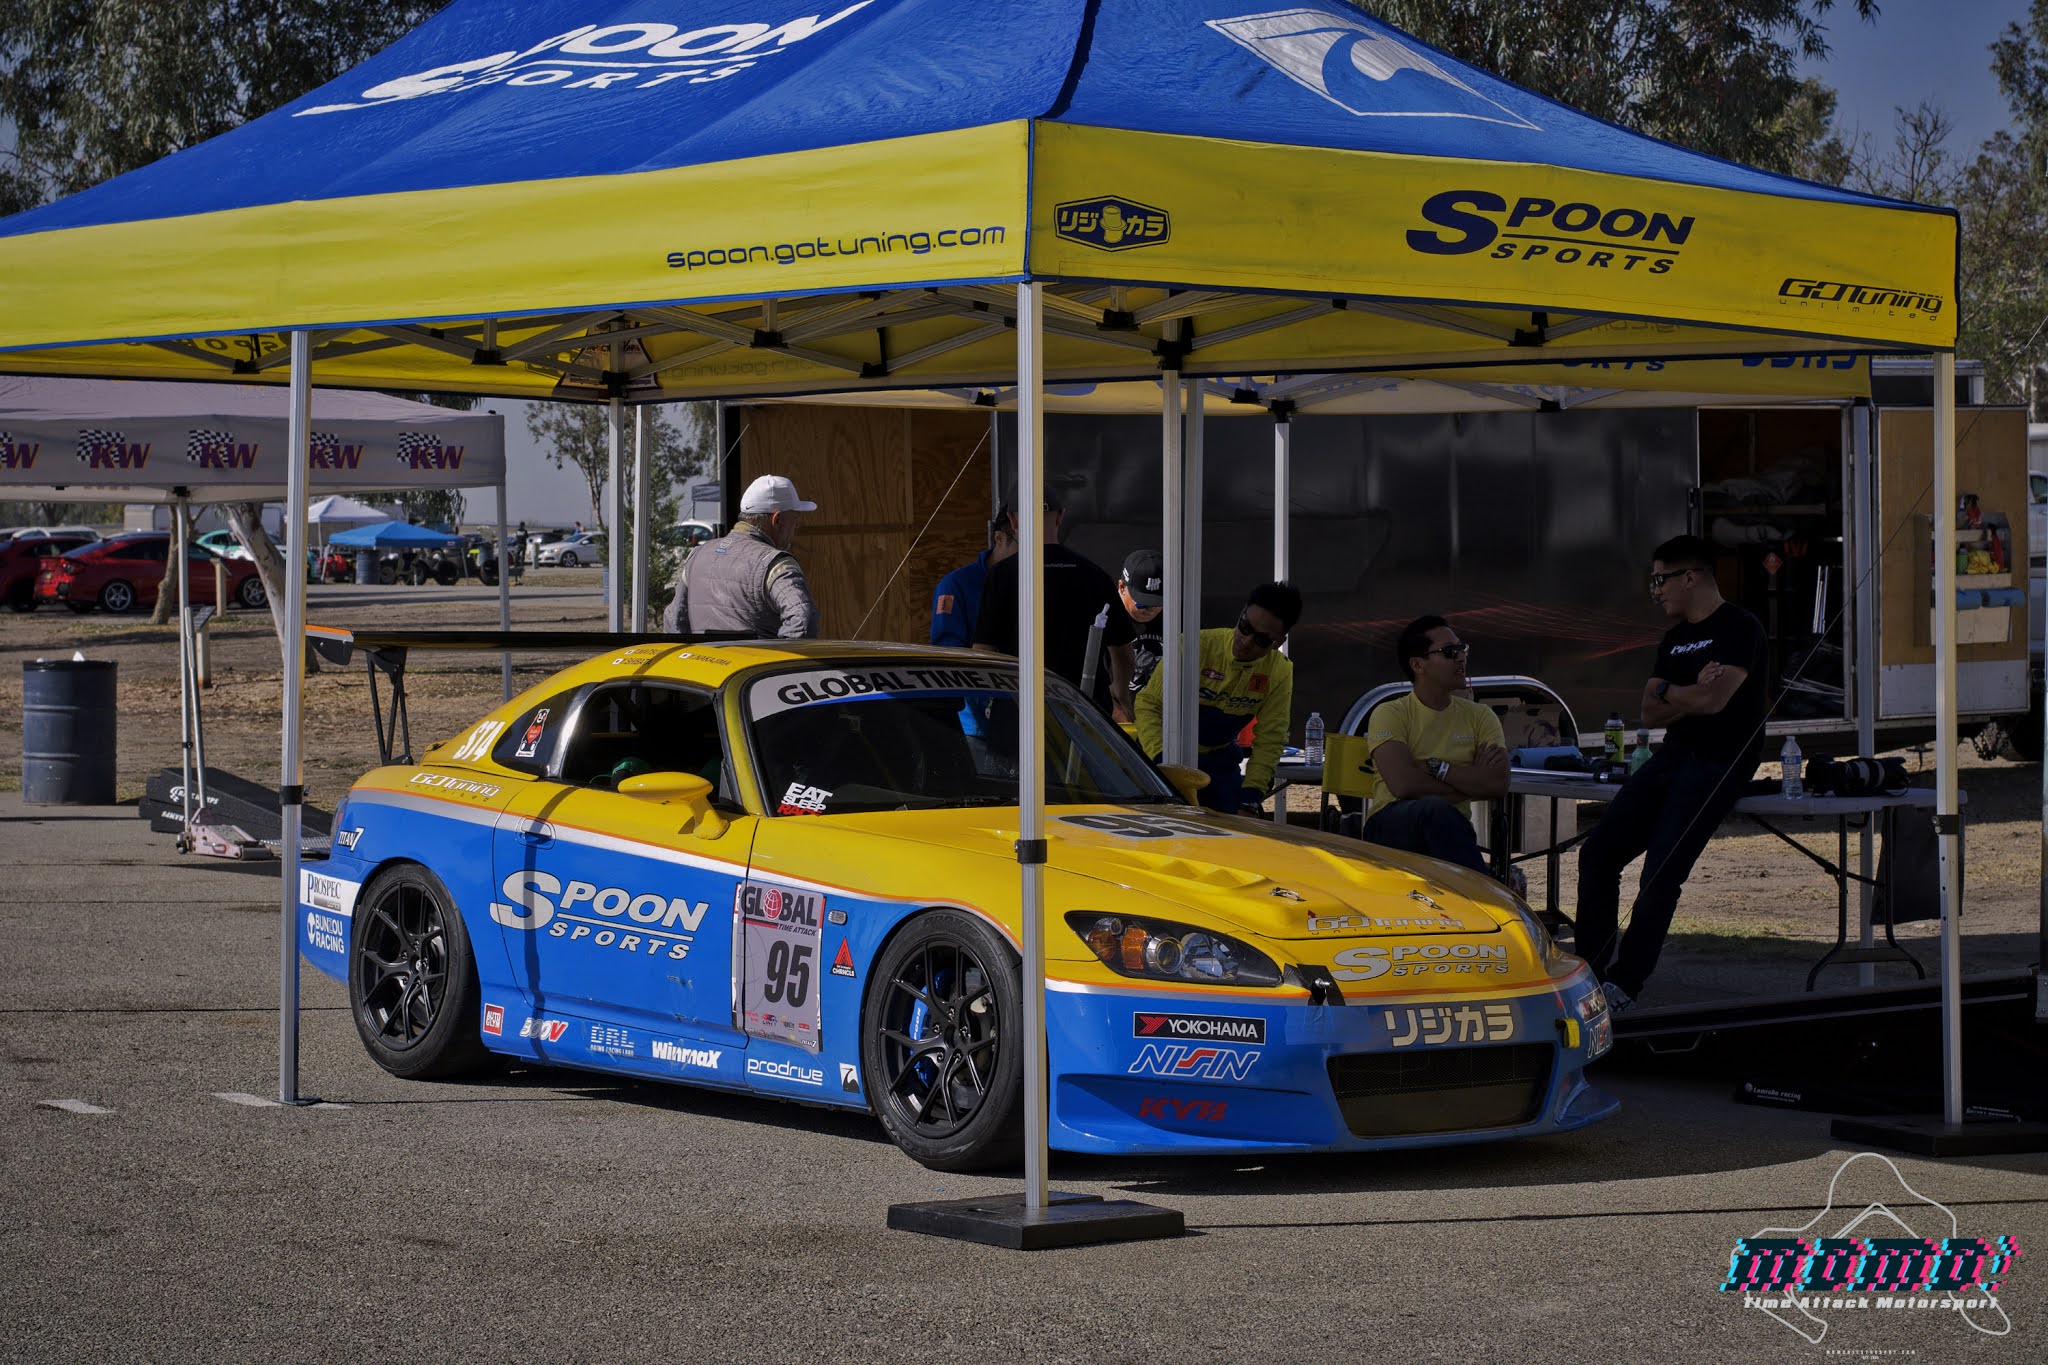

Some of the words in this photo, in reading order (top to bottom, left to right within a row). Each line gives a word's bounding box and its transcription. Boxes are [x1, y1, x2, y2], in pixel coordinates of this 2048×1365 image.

[1406, 190, 1696, 255] SPOON
[667, 225, 1005, 271] spoon.gotuning.com
[1490, 243, 1676, 274] SPORTS
[0, 443, 39, 469] W
[89, 443, 152, 470] KW
[198, 443, 260, 470] KW
[409, 445, 465, 470] KW
[777, 670, 917, 705] GLOBAL
[913, 669, 985, 688] TIME
[781, 795, 827, 812] SLEEP
[785, 782, 833, 804] EAT
[307, 873, 342, 903] PROSPEC
[489, 870, 710, 934] SPOON
[740, 886, 818, 927] GLOBAL
[315, 932, 345, 954] RACING
[549, 920, 692, 960] SPORTS
[778, 923, 793, 932] TIME
[793, 926, 817, 936] ATTACK
[764, 940, 813, 1008] 95
[1331, 944, 1508, 982] SPOON
[1392, 963, 1509, 977] SPORTS
[486, 1010, 502, 1021] AUTO
[1168, 1019, 1259, 1038] YOKOHAMA
[1384, 1004, 1515, 1048] リジカラ
[519, 1017, 569, 1043] 300V
[747, 1058, 823, 1081] prodrive
[1138, 1097, 1229, 1121] KYB
